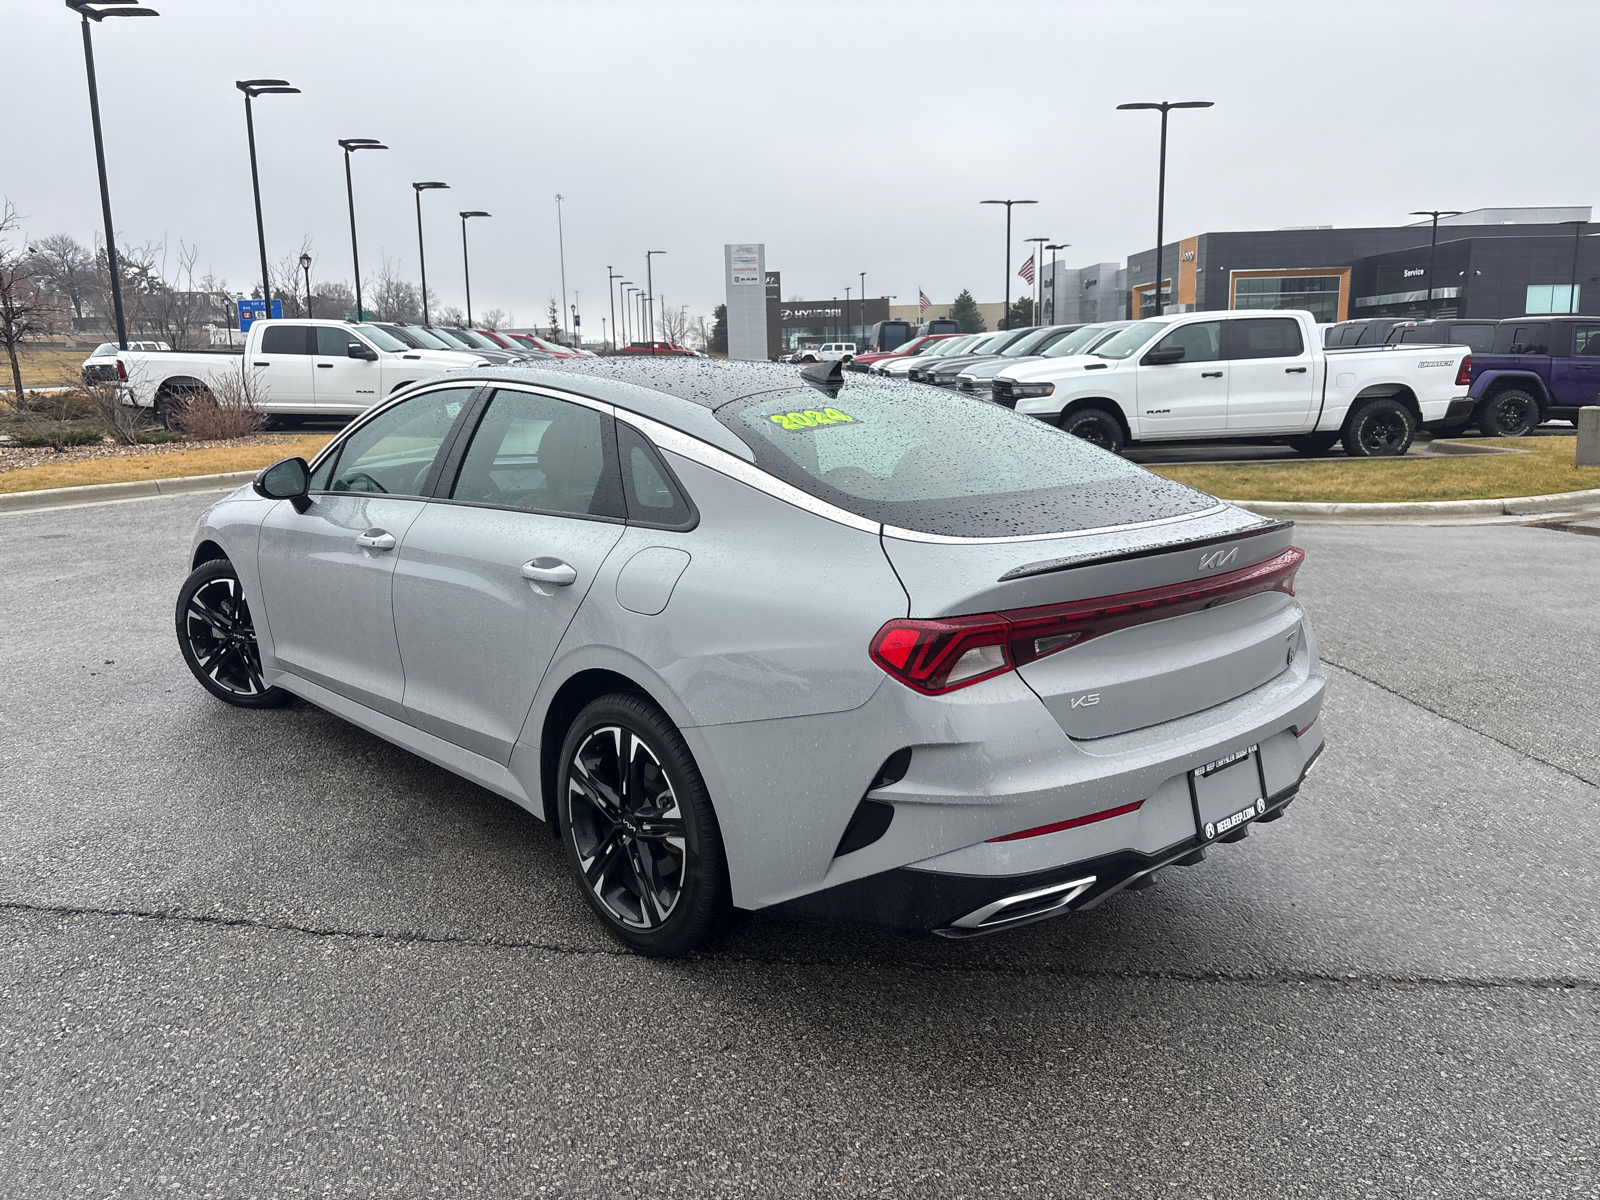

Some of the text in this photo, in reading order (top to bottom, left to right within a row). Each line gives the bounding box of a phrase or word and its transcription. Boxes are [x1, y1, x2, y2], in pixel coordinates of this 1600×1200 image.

[1182, 251, 1194, 261] Jeep
[1403, 267, 1425, 278] Service
[795, 308, 841, 318] HYUNDAI
[770, 408, 854, 430] 2024
[1197, 547, 1239, 571] KIA
[1070, 693, 1100, 710] K5
[1195, 766, 1205, 776] REED
[1206, 762, 1215, 771] JEEP
[1216, 754, 1235, 767] CHRYSLER
[1236, 748, 1248, 759] DODGE
[1217, 806, 1255, 833] REEDJEEP.COM
